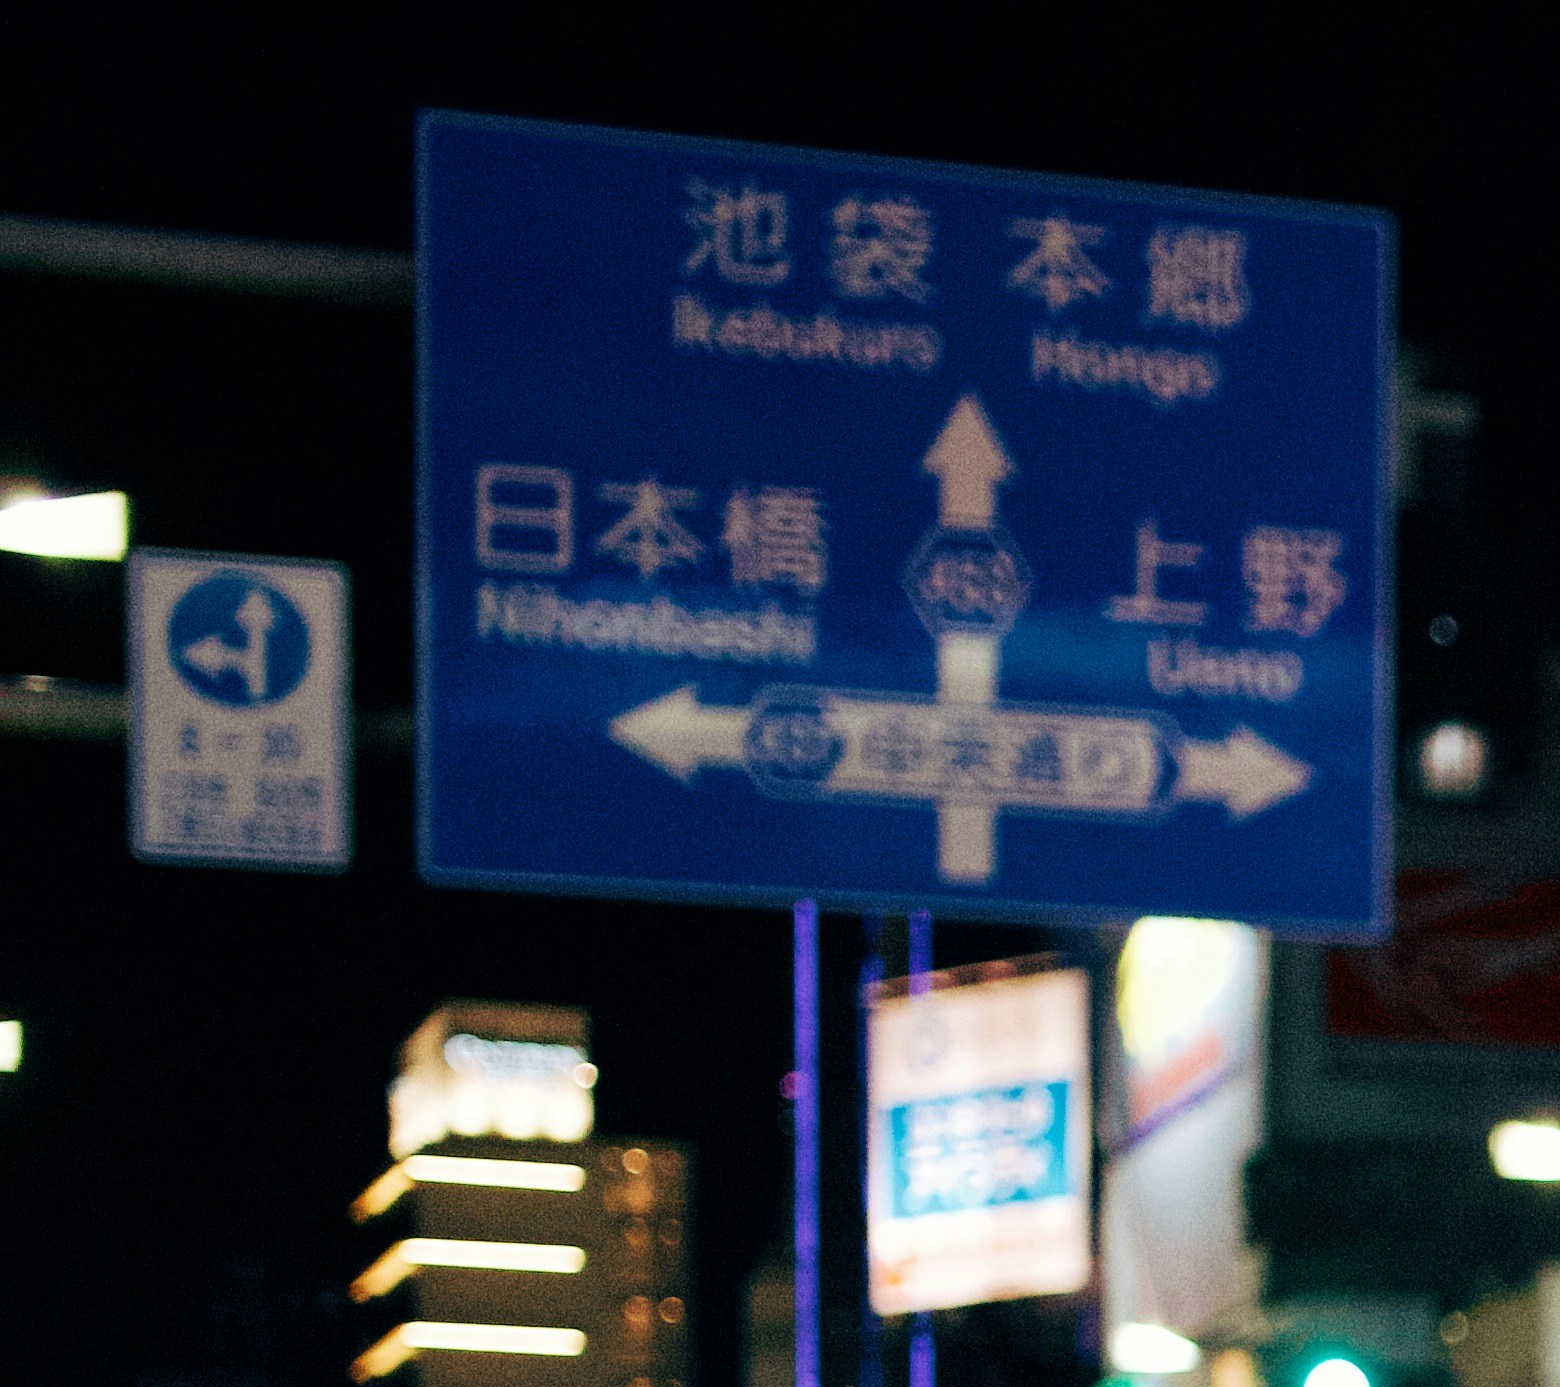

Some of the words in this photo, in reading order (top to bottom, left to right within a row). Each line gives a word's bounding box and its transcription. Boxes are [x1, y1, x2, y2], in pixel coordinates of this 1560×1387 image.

[680, 178, 936, 302] 池袋
[1003, 213, 1250, 328] 本郷
[674, 293, 940, 370] Ikebukuro
[1031, 328, 1222, 403] Hongo
[474, 463, 829, 594] 日本橋
[1104, 518, 1347, 638] 上野
[474, 580, 818, 662] Nihonbashi
[1147, 638, 1304, 702] Ueno
[856, 715, 1142, 788] 中央通り
